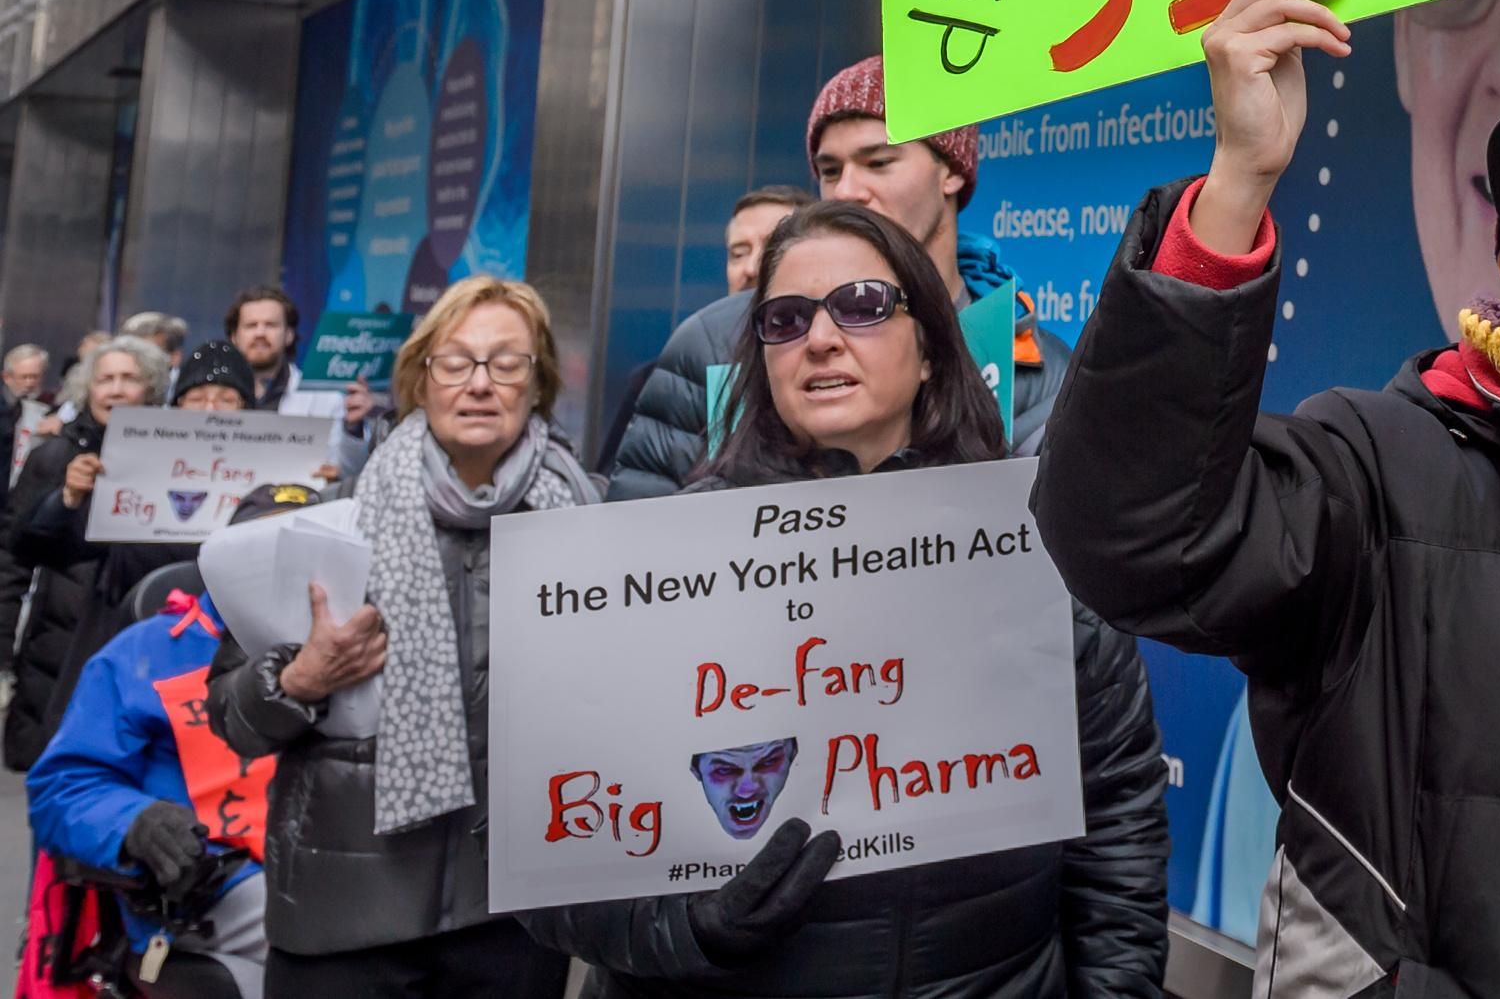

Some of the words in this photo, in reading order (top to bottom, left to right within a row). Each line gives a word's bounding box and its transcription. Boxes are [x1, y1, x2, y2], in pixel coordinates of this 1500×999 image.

[977, 118, 1034, 160] public
[1040, 113, 1090, 152] from
[1097, 101, 1216, 148] infectious
[993, 200, 1074, 242] disease,
[1080, 204, 1130, 235] now
[1037, 280, 1073, 322] the
[326, 353, 358, 378] for
[752, 503, 847, 539] Pass
[536, 581, 608, 617] the
[623, 570, 718, 608] New
[728, 551, 819, 592] York
[832, 533, 956, 579] Health
[967, 522, 1033, 561] Act
[785, 599, 815, 622] to
[544, 769, 664, 857] Big
[821, 732, 1042, 816] Pharma
